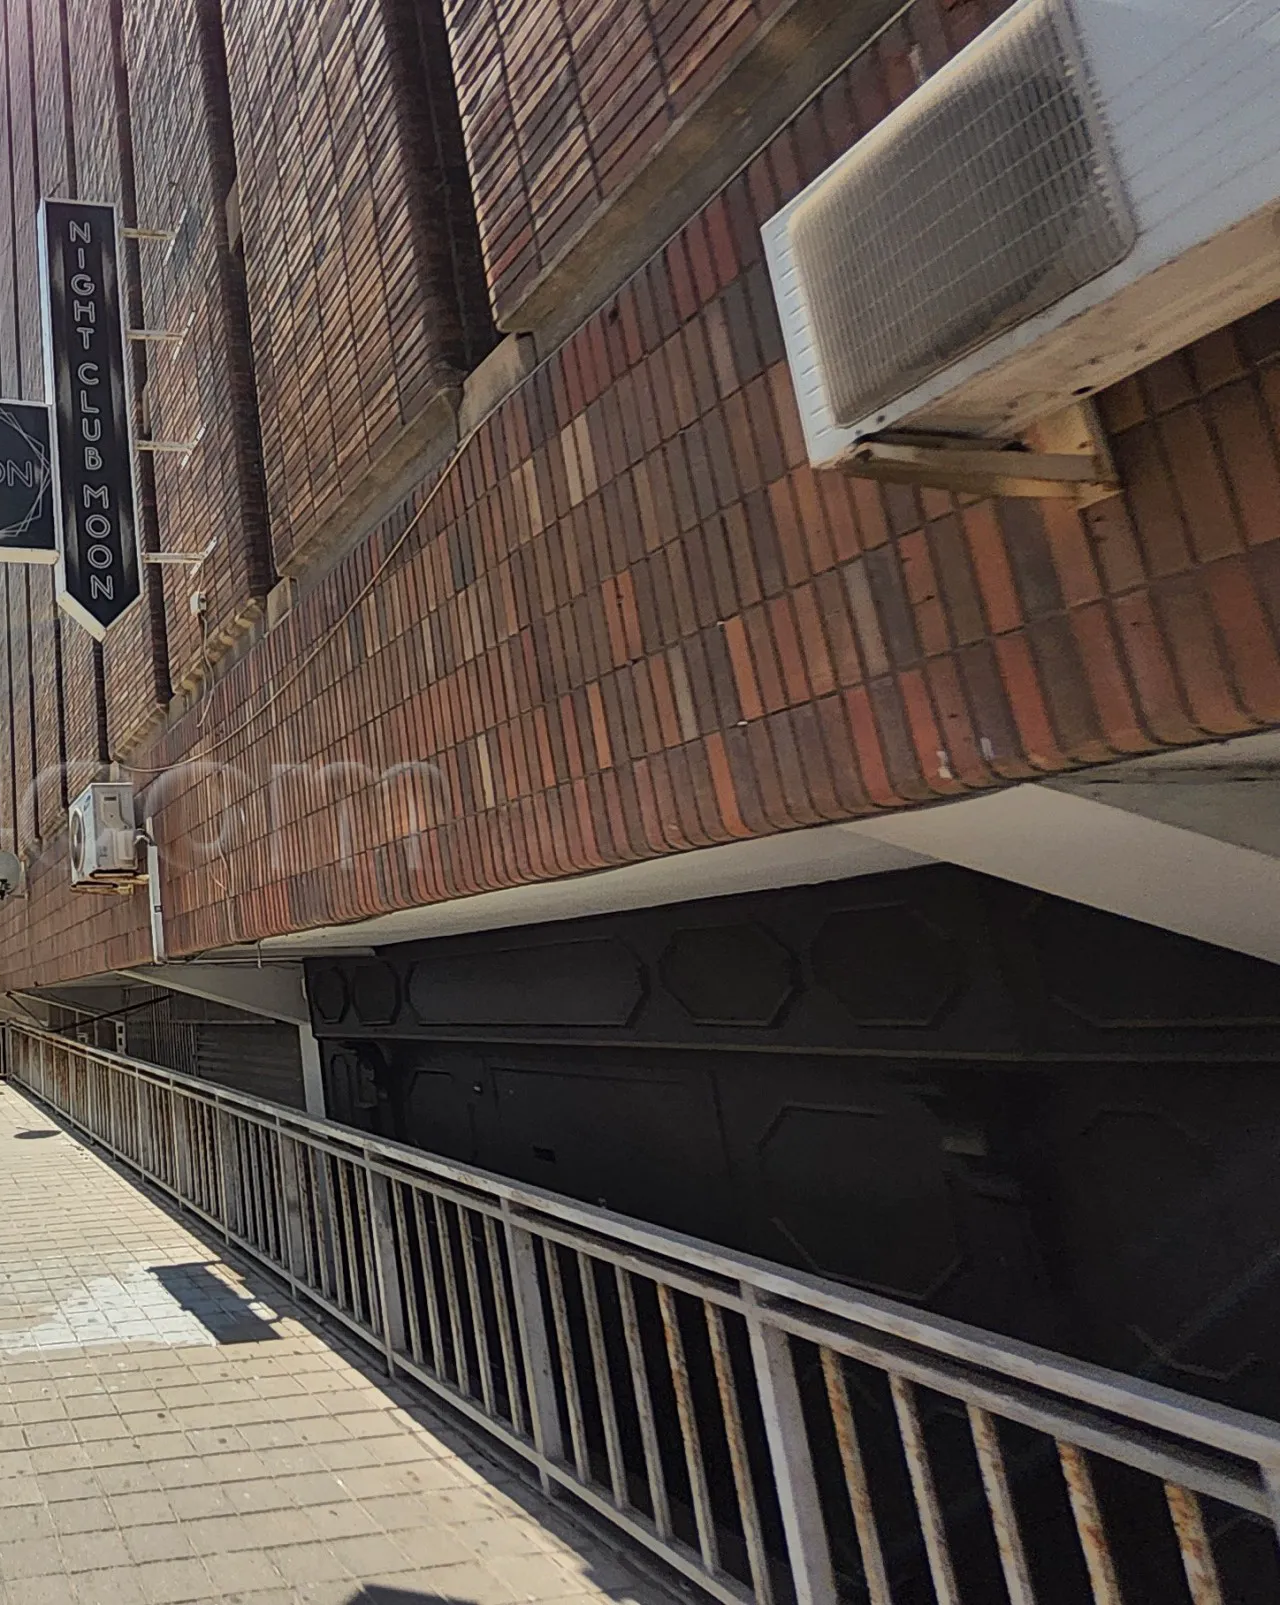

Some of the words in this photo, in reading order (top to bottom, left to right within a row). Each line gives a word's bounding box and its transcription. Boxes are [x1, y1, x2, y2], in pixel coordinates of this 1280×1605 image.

[68, 220, 96, 351] NIGHT
[77, 361, 104, 471] CLUB
[82, 484, 115, 600] MOON
